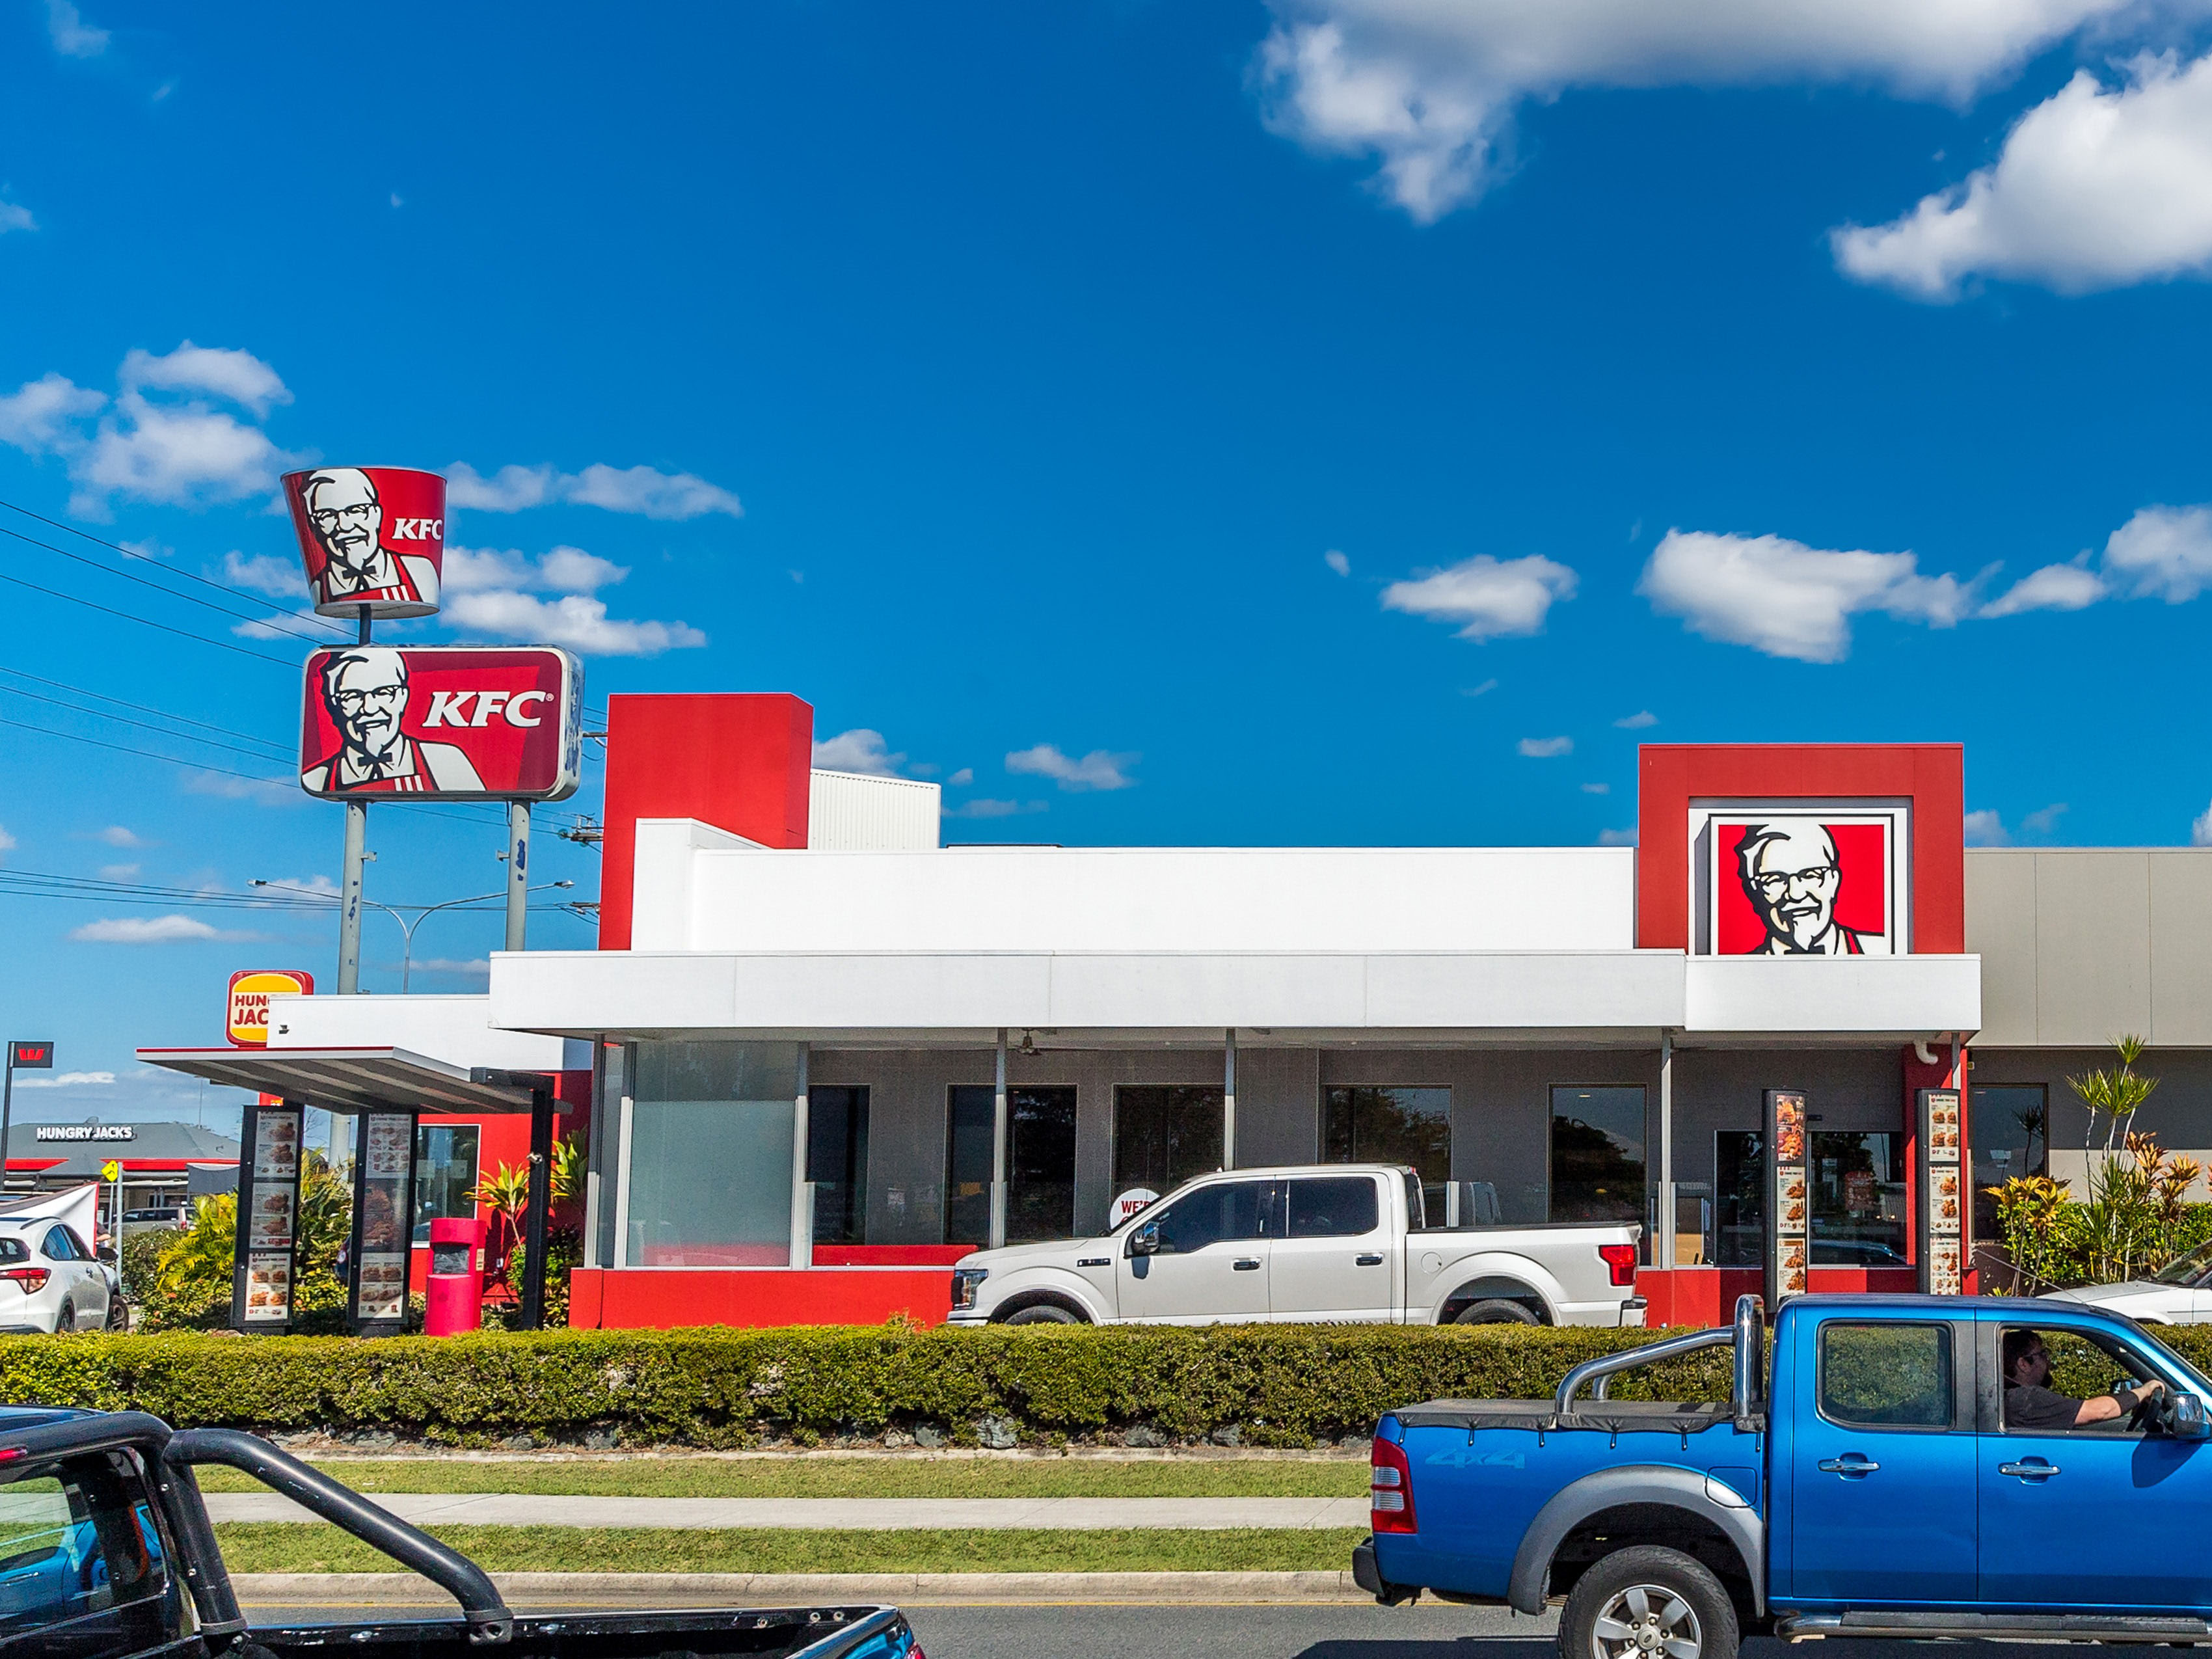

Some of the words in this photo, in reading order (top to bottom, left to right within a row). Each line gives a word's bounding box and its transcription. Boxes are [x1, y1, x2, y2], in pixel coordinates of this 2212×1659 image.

[392, 517, 443, 541] KFC
[235, 995, 269, 1006] HUN
[36, 1127, 92, 1139] HUNGRY
[1425, 1448, 1525, 1468] 4x4
